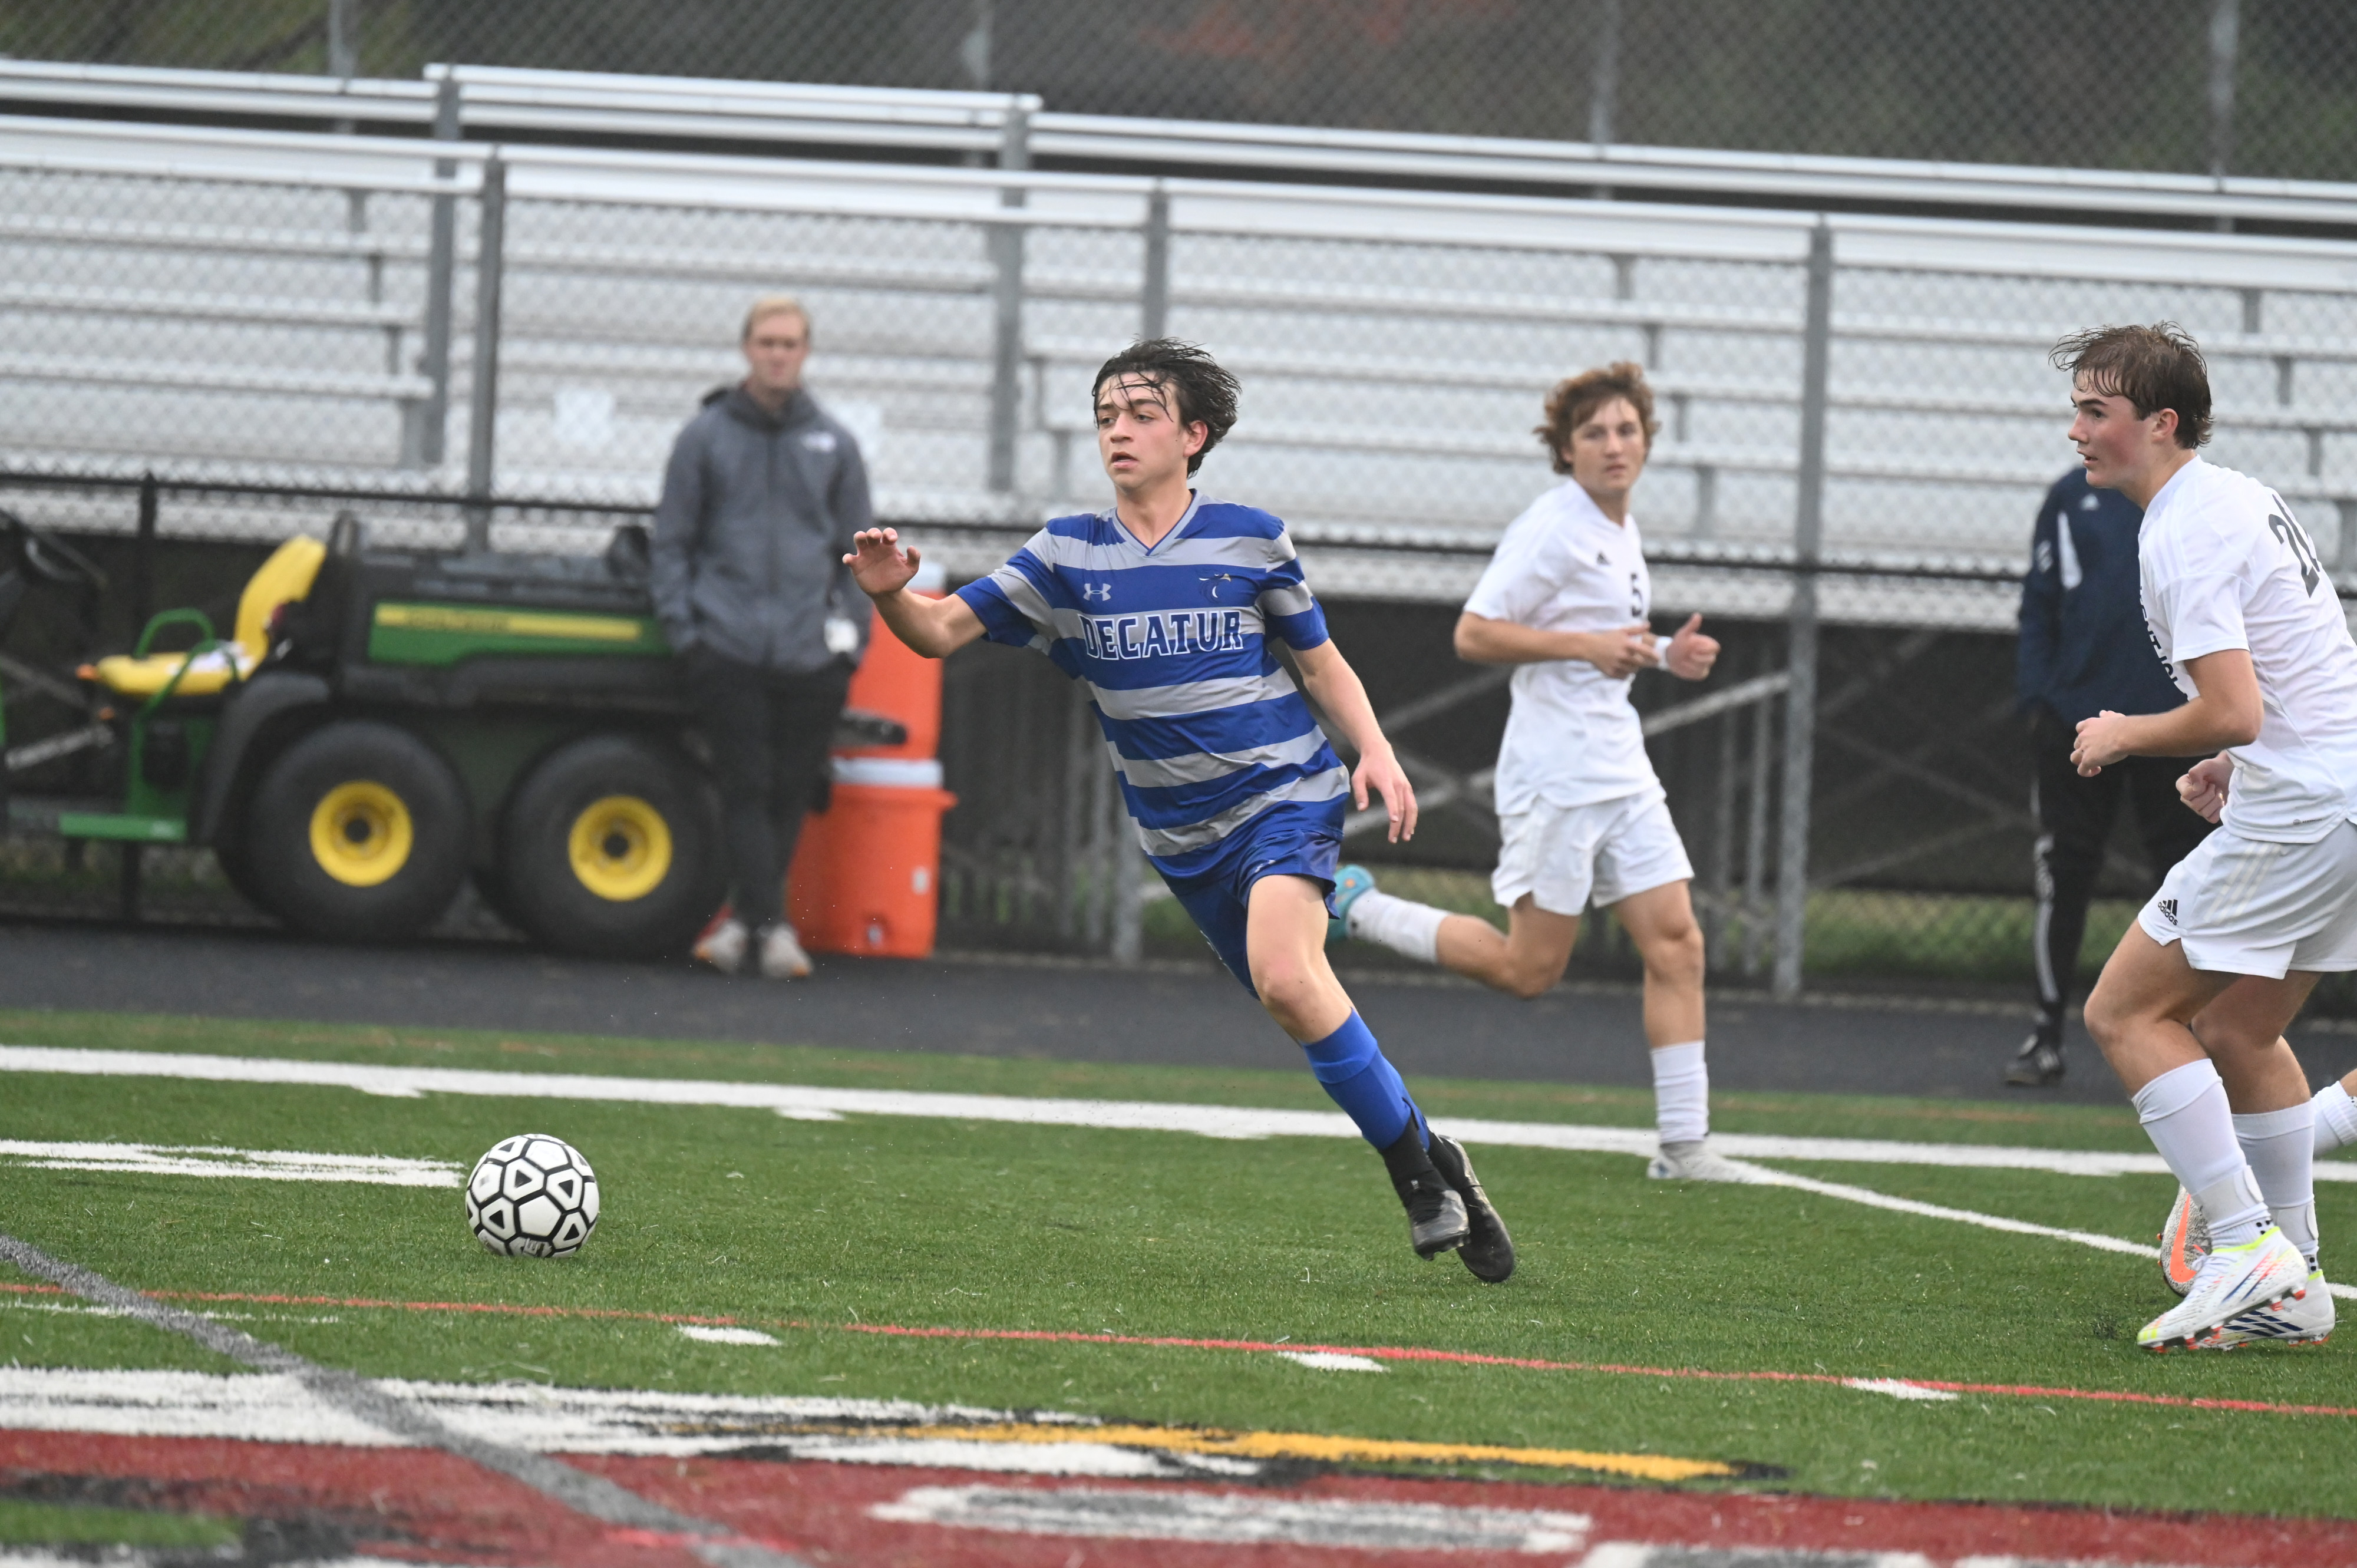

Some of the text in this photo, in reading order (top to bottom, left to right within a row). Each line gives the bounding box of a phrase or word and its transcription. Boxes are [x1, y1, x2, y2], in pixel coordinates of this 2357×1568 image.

[1630, 573, 1643, 617] 5
[1078, 610, 1243, 660] DECATUR
[2157, 902, 2178, 926] adidas
